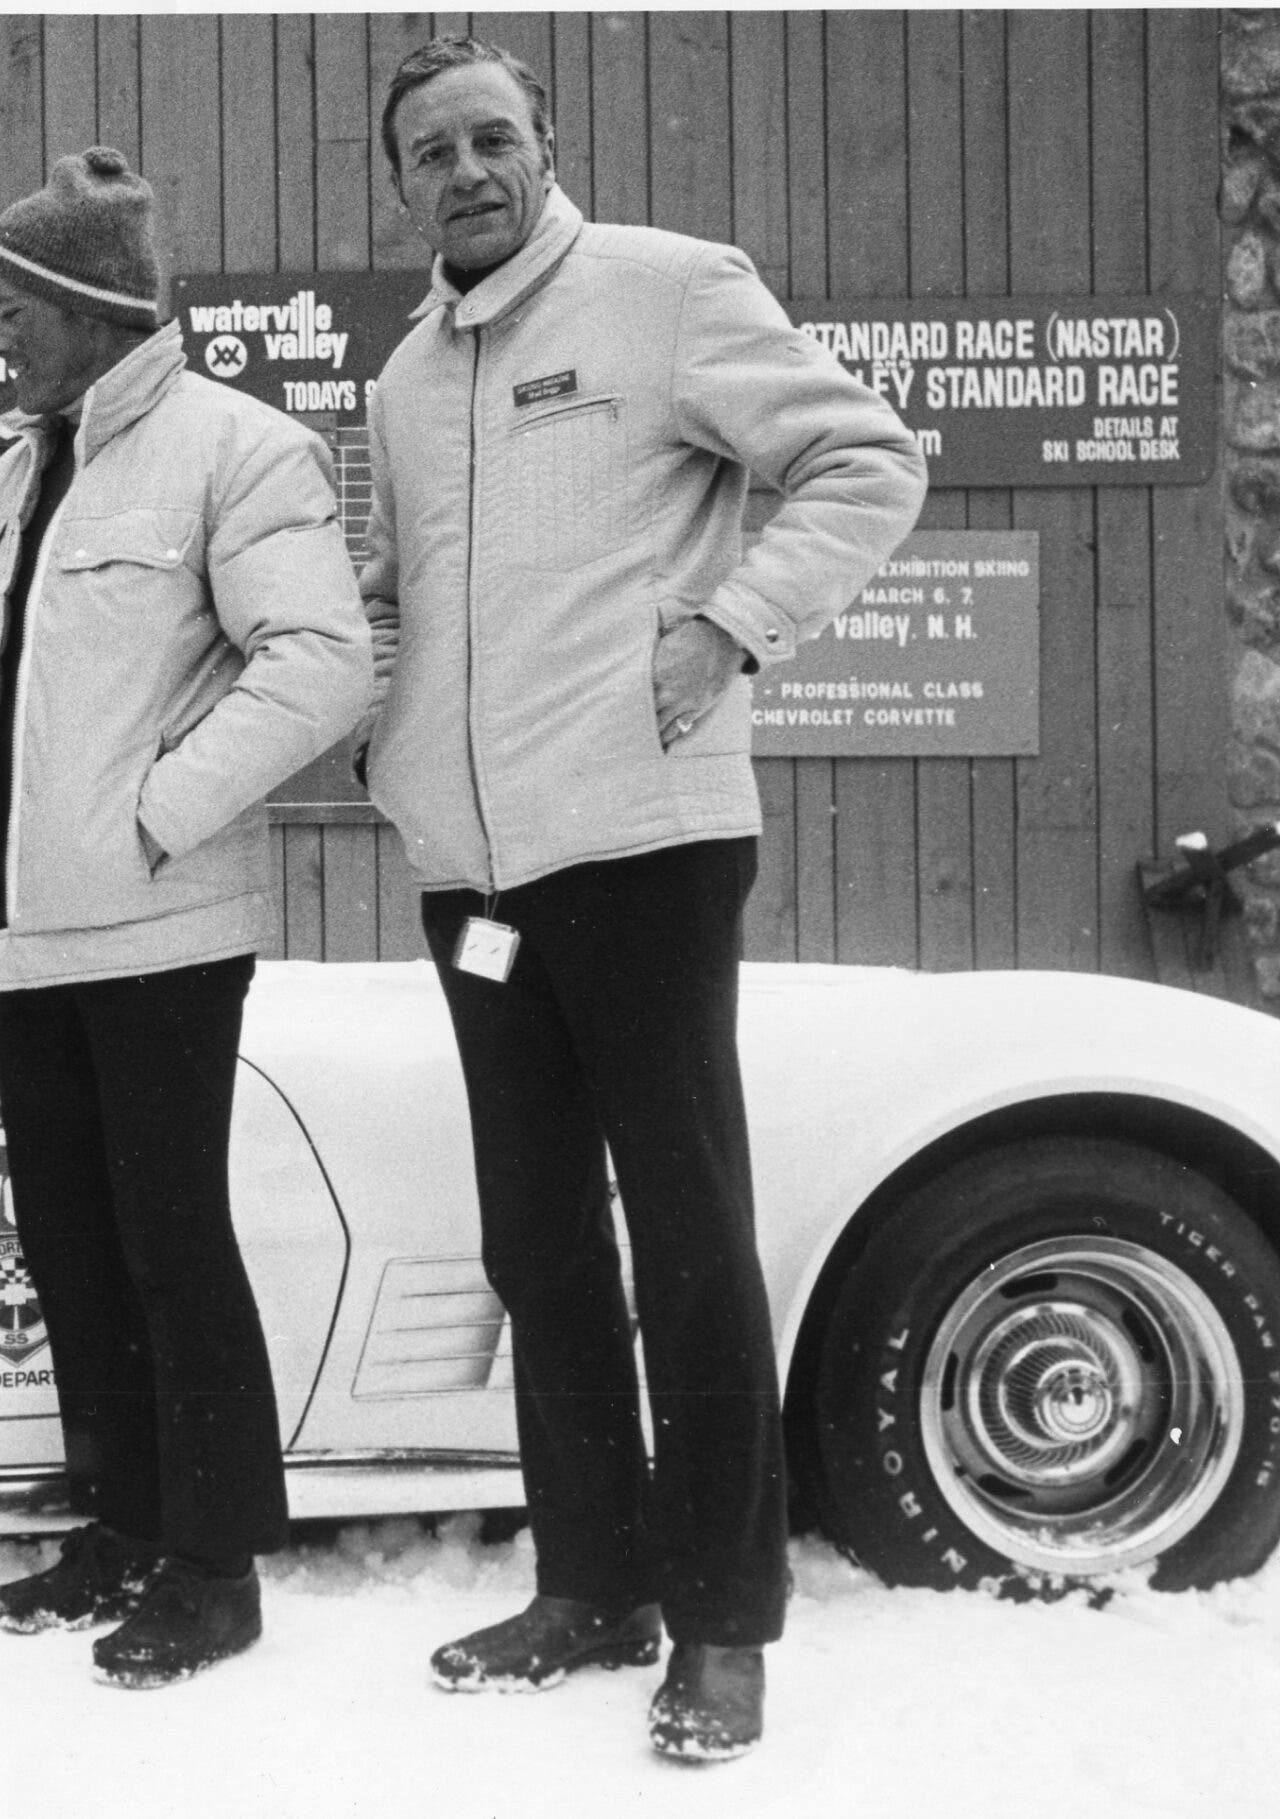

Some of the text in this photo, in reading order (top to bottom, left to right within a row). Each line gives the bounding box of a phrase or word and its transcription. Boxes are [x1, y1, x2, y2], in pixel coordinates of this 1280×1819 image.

[190, 291, 332, 332] waterville
[956, 320, 1034, 360] RACE
[1046, 308, 1180, 362] (NASTAR)
[265, 332, 348, 369] valley
[284, 381, 356, 411] TODAYS
[856, 364, 1179, 409] EY STANDARD RACE
[1094, 416, 1179, 438] DETAILS AT
[1042, 439, 1181, 462] SKI SCHOOL DESK
[861, 588, 923, 604] MARCH
[781, 683, 912, 699] PROFESSIONAL
[924, 682, 983, 698] CLASS
[752, 709, 956, 726] CHEVROLET CORVETTE
[1160, 1211, 1236, 1278] TIGER
[4, 1333, 29, 1345] SS
